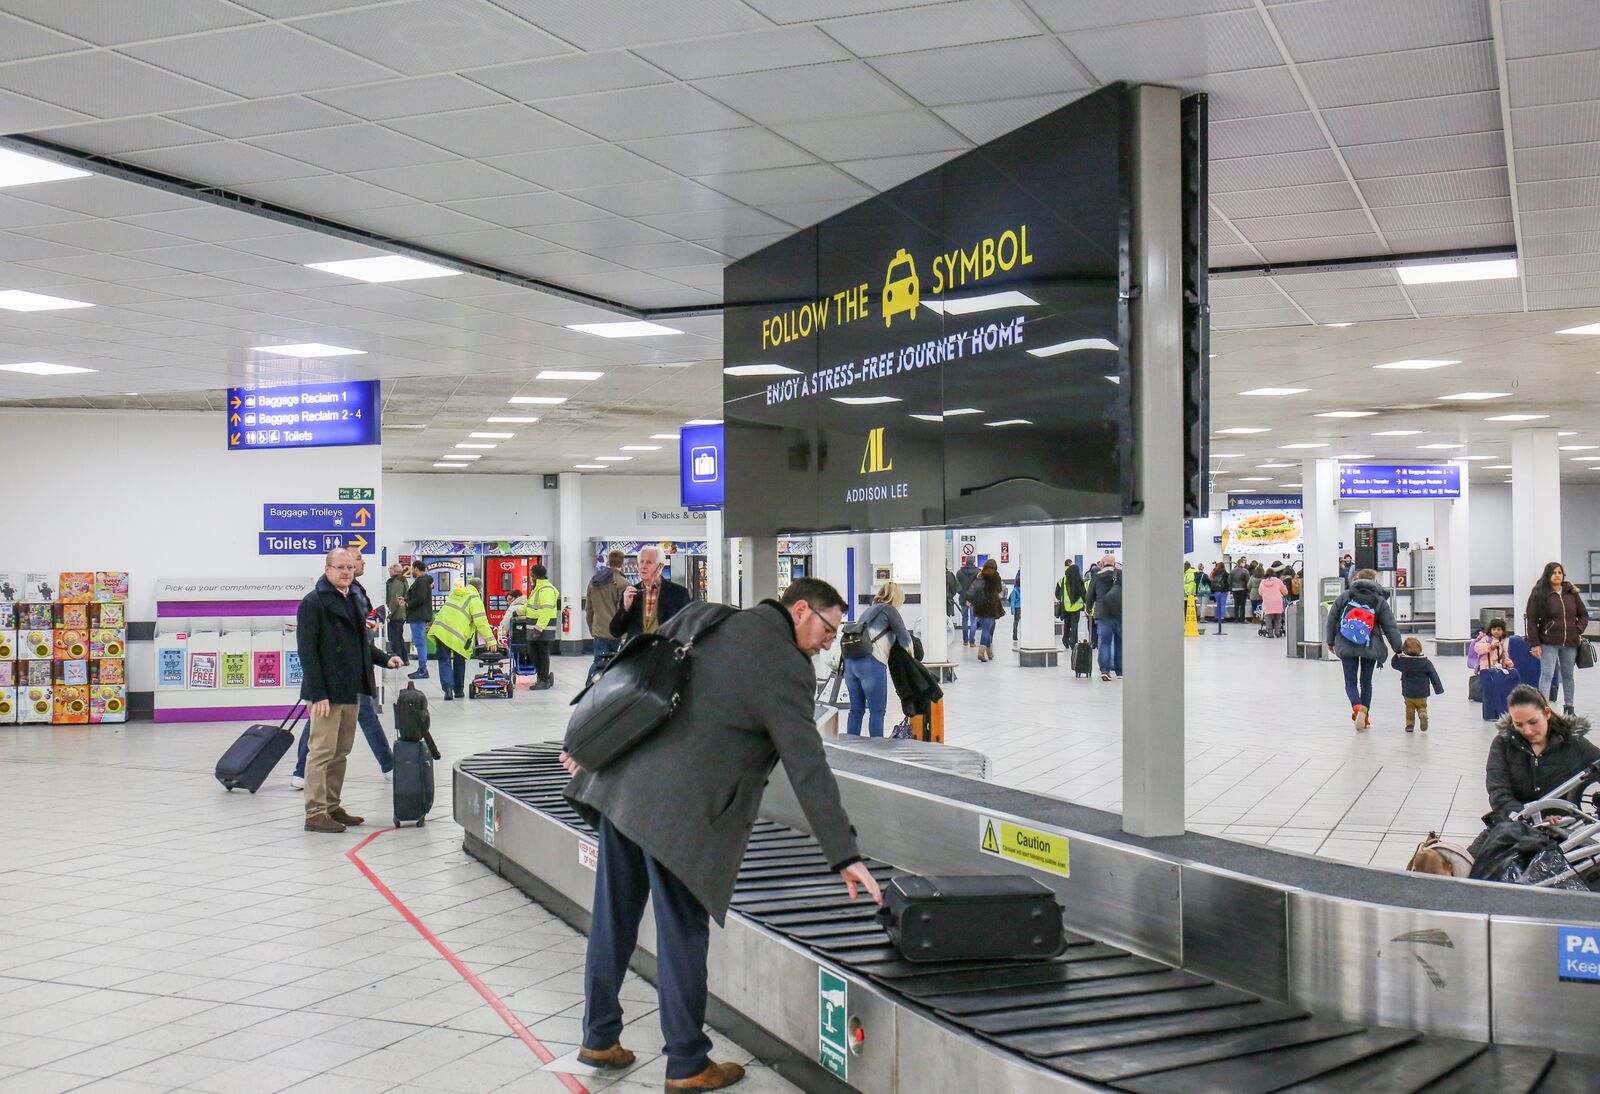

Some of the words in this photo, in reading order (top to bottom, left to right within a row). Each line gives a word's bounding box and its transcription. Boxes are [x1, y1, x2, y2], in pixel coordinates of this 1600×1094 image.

[762, 297, 829, 350] FOLLOW
[834, 283, 868, 325] THE
[932, 225, 1033, 294] SYMBOL
[766, 377, 800, 406] ENJOY
[801, 376, 809, 397] A
[812, 352, 895, 394] STRESS-FREE
[896, 331, 968, 374] JOURNEY
[971, 316, 1025, 355] HOME
[259, 395, 299, 407] Baggage
[301, 392, 339, 404] Reclaim
[342, 392, 347, 401] 1
[259, 413, 299, 425] Baggage
[301, 410, 339, 422] Reclaim
[283, 431, 313, 442] Toilets
[846, 485, 887, 503] ADDISON
[891, 483, 908, 499] LEE
[270, 508, 308, 517] Baggage
[310, 508, 343, 517] Trolleys
[651, 511, 680, 519] Snacks
[266, 536, 317, 550] Toilets
[402, 565, 411, 577] 2
[220, 584, 283, 592] complimentary
[285, 584, 306, 592] copy
[1397, 576, 1405, 587] 2
[192, 672, 213, 680] FREE
[1016, 831, 1051, 854] Caution
[1568, 959, 1600, 976] Kee
